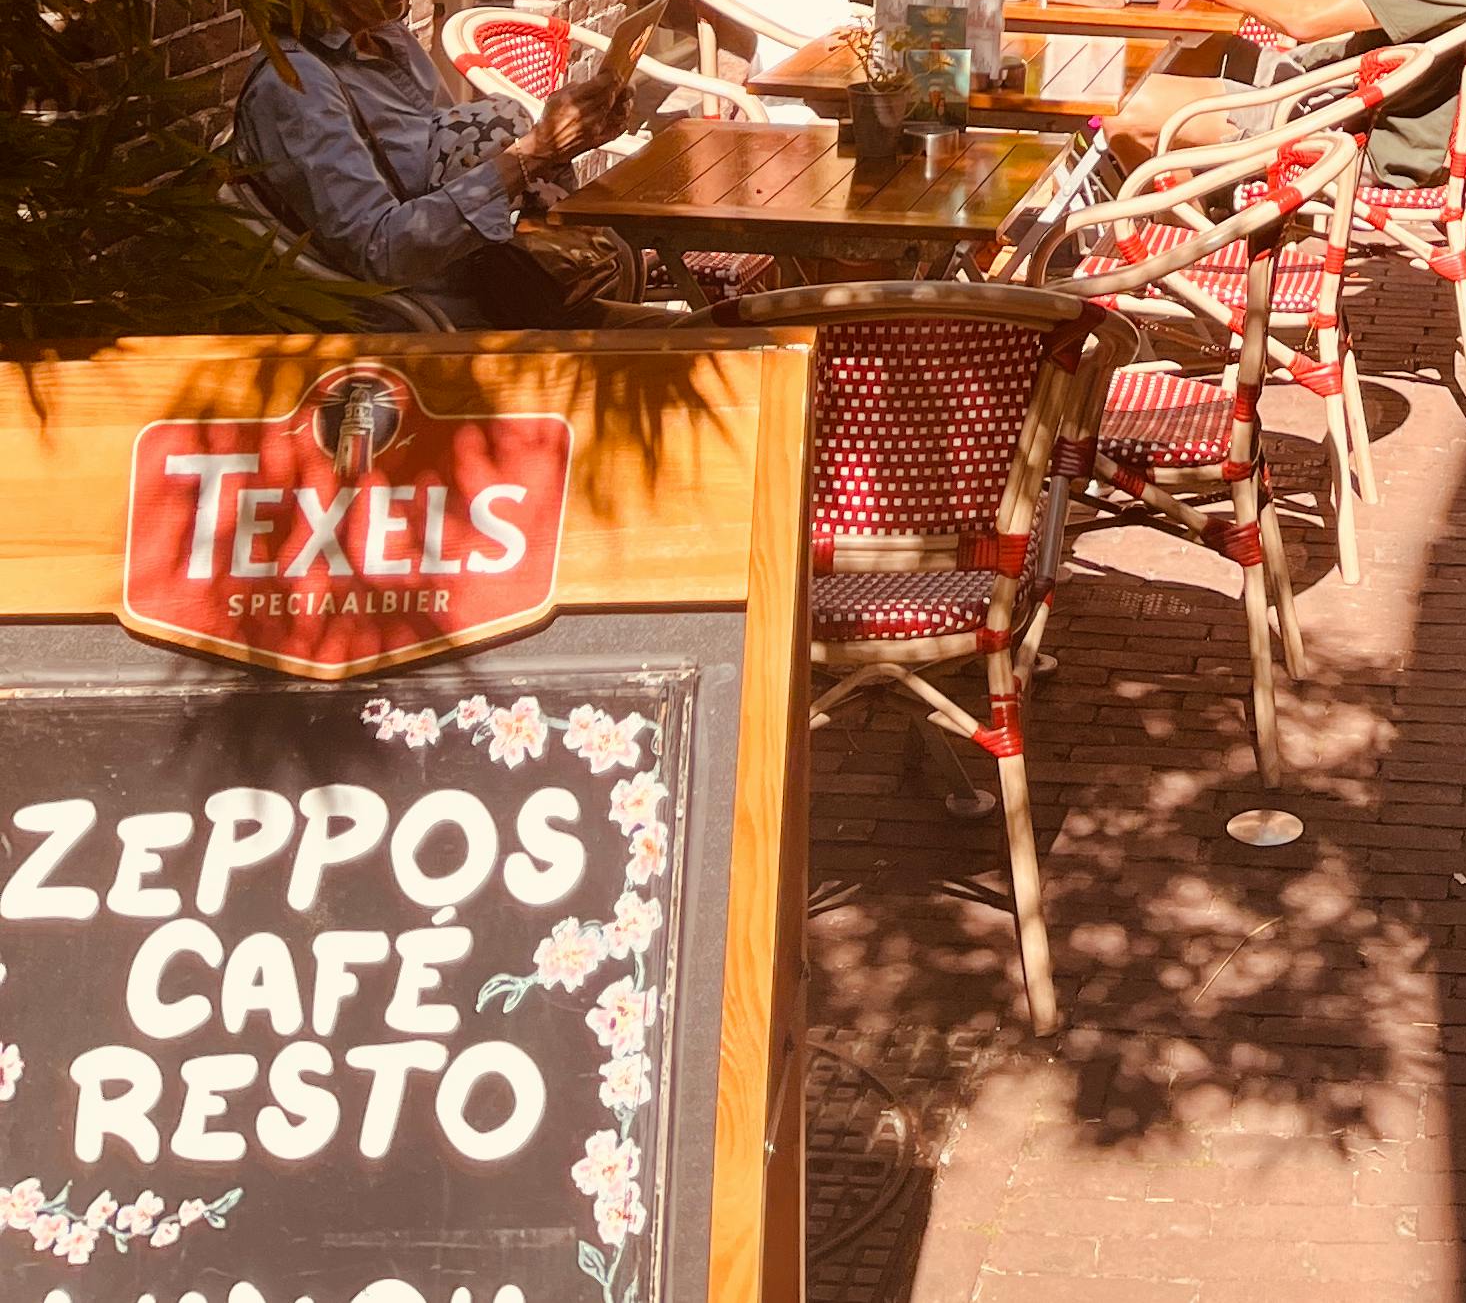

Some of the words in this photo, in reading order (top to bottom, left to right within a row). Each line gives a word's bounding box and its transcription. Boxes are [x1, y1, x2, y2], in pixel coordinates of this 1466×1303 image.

[164, 453, 529, 580] TEXELS
[228, 590, 450, 618] SPECIAALBIER
[1, 785, 586, 921] ZEPPOS
[127, 905, 473, 1040] CAFÉ
[69, 1039, 547, 1164] RESTO
